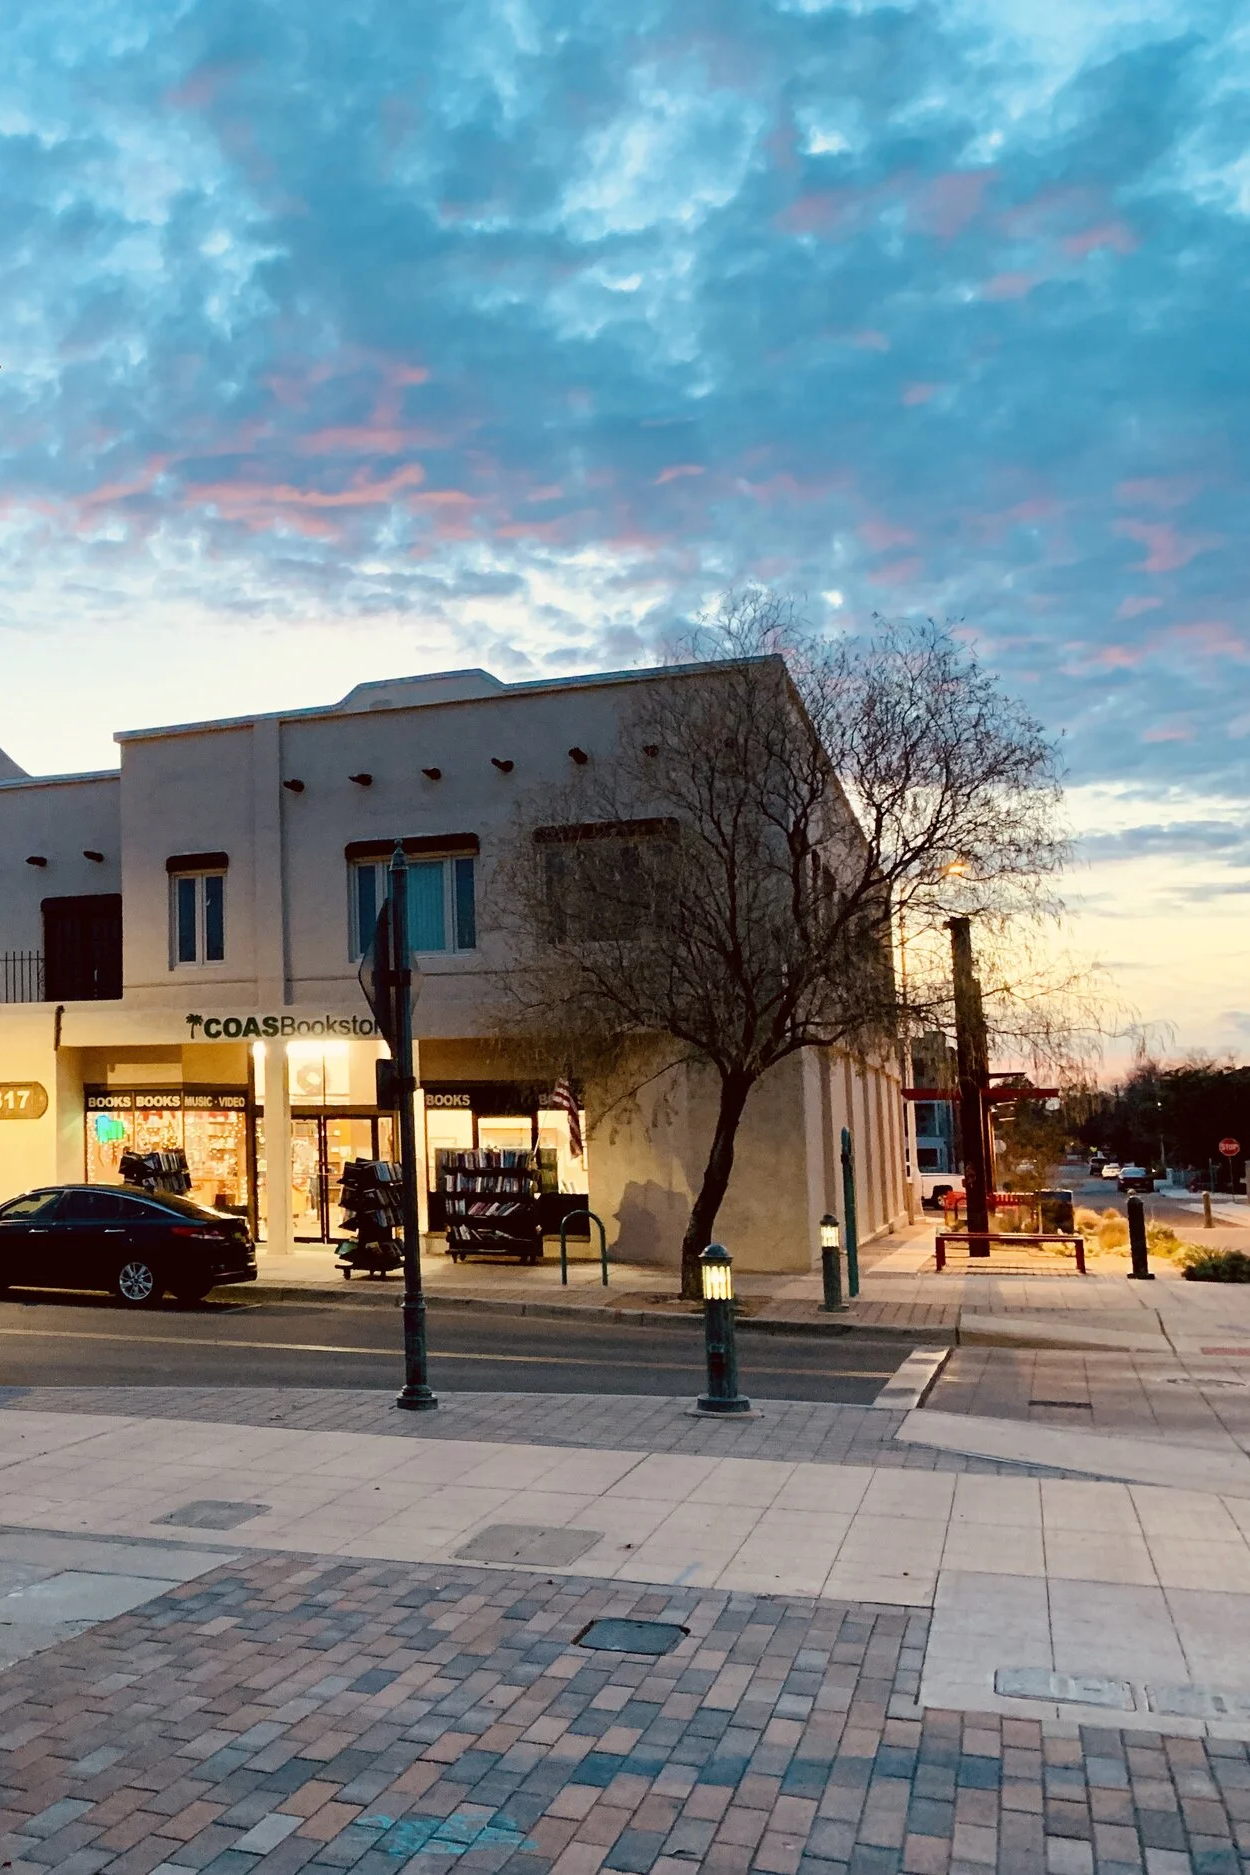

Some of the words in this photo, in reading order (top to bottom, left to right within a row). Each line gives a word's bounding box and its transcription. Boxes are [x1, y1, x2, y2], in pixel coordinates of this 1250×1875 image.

[88, 1096, 132, 1108] BOOKS
[136, 1096, 181, 1108] BOOKS
[184, 1096, 213, 1107] MUSIC
[218, 1096, 245, 1107] VIDEO
[425, 1094, 471, 1107] BOOKS
